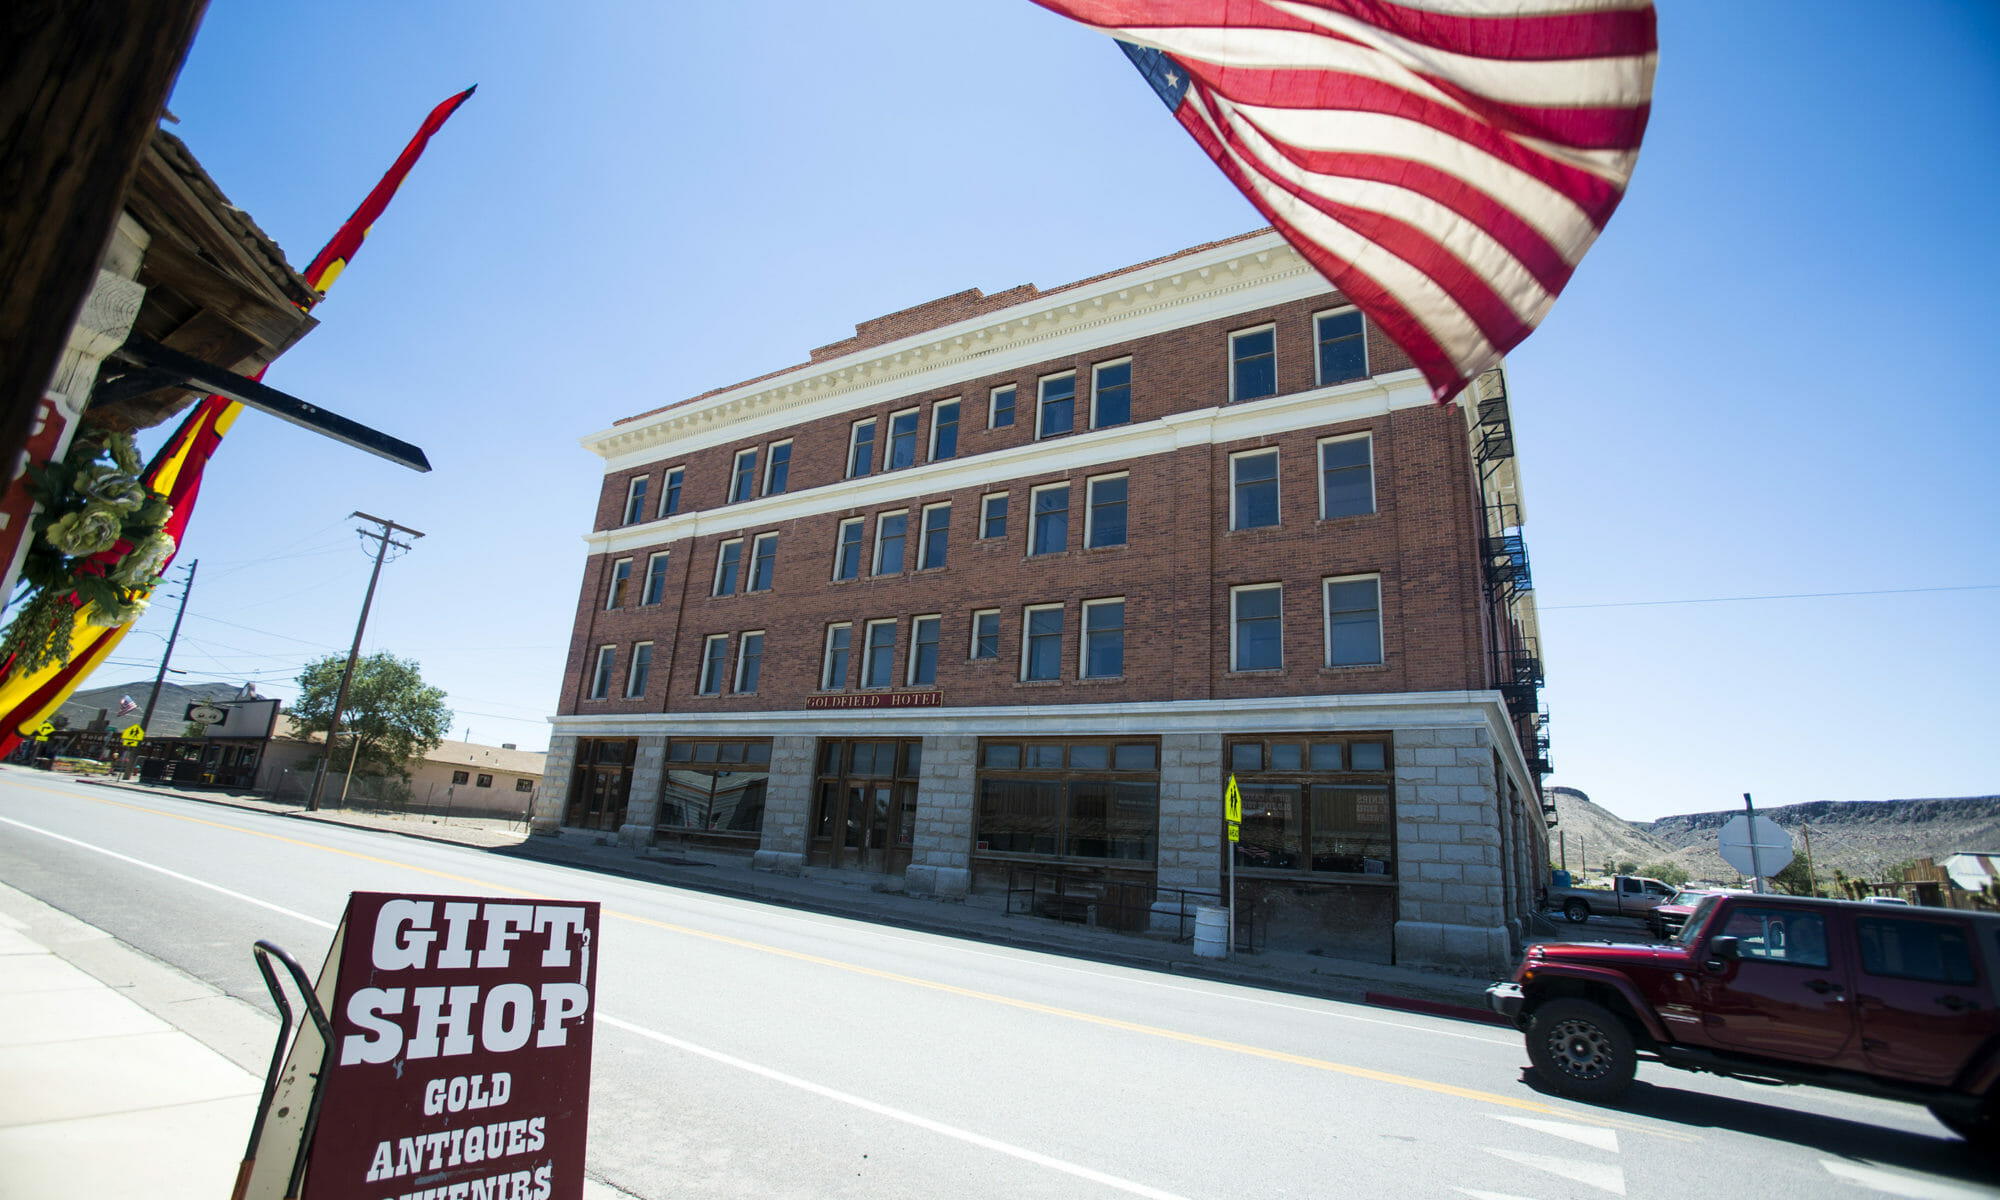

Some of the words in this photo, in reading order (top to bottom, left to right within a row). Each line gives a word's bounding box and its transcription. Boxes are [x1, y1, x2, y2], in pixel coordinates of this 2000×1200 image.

[807, 695, 880, 707] GOLDFIELD
[892, 693, 940, 706] HOTEL
[372, 900, 586, 970] GIFT
[340, 983, 589, 1066] SHOP
[423, 1072, 512, 1116] GOLD
[366, 1116, 546, 1183] ANTIQUES
